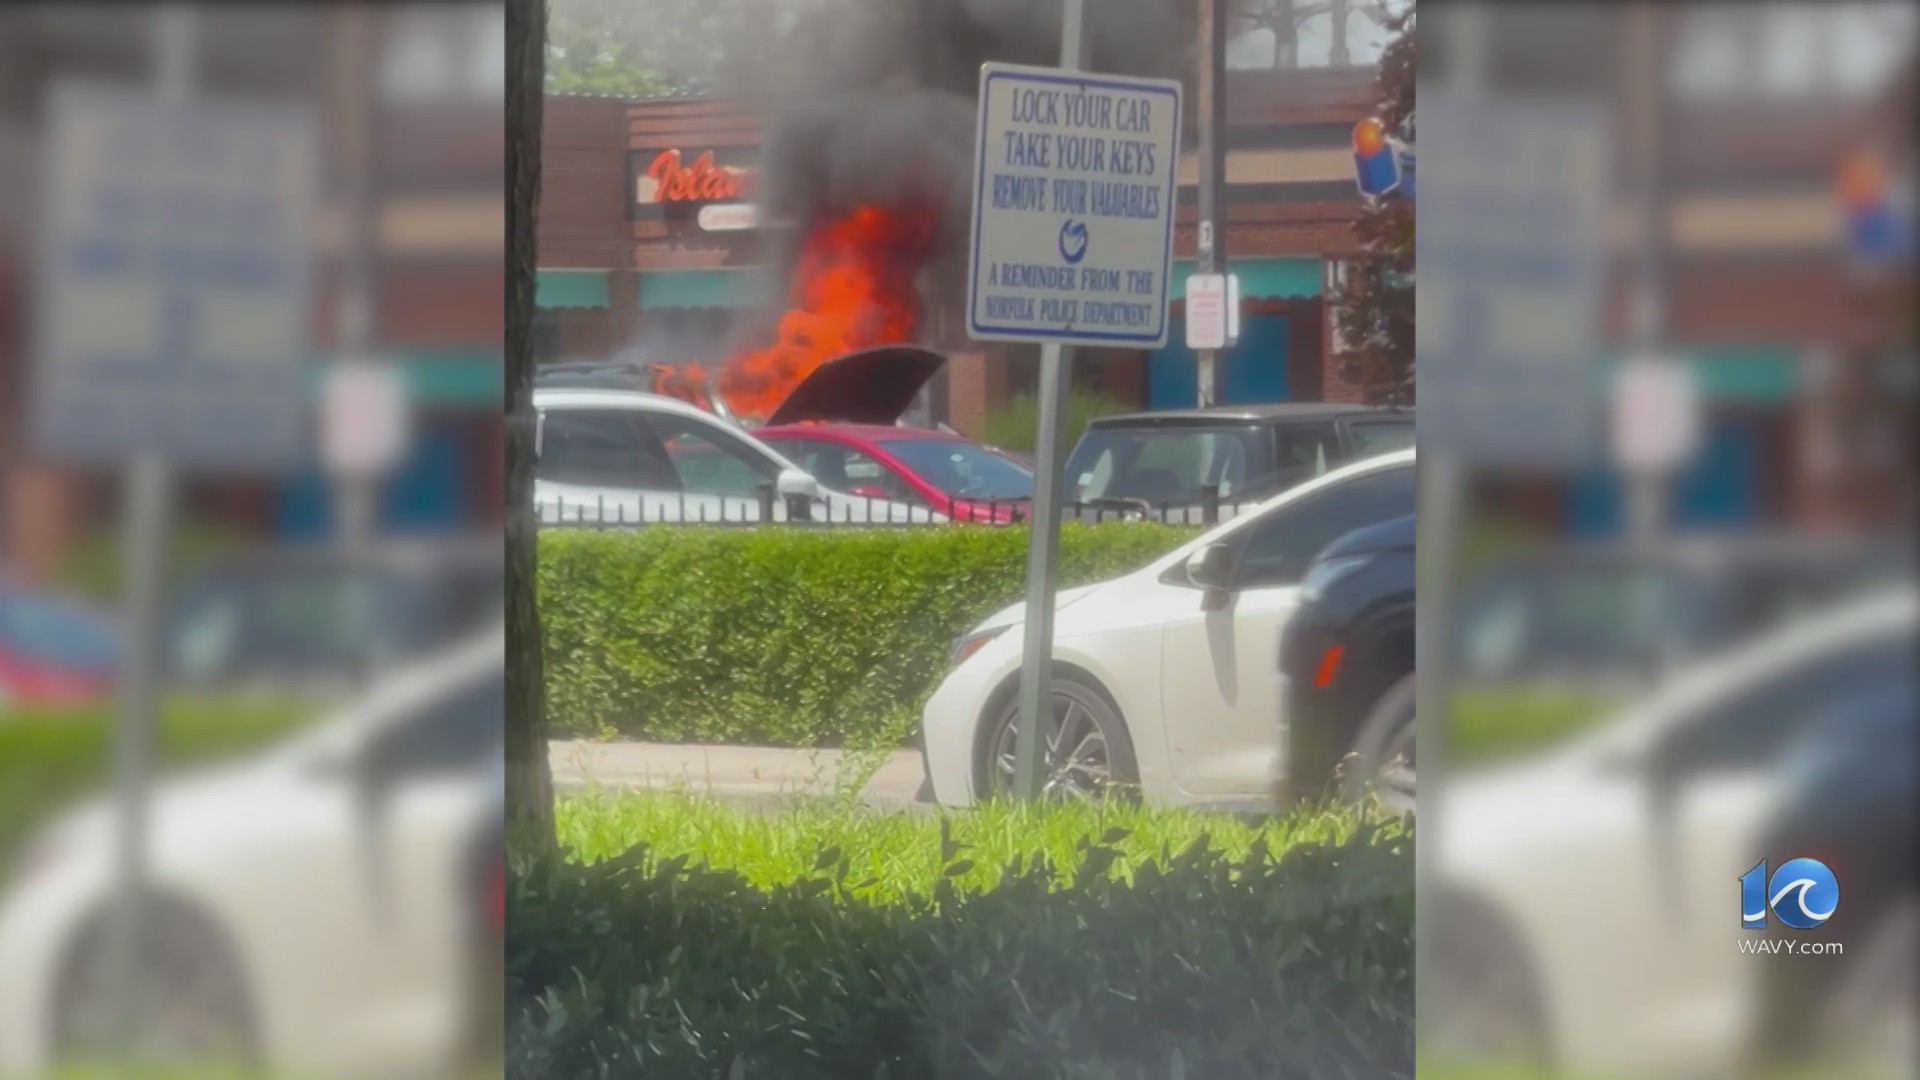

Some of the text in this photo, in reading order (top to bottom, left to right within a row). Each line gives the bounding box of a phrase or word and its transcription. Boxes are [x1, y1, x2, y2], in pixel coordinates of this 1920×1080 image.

[1011, 87, 1152, 133] LOCK YOUR CAR
[1004, 130, 1157, 176] TAKE YOUR KEYS
[992, 173, 1160, 219] REMOVE YOUR VALUABLES
[988, 262, 1153, 294] A REMINDER FROM THE
[985, 296, 1153, 327] NORFOLK POLICE DEPARTMENT
